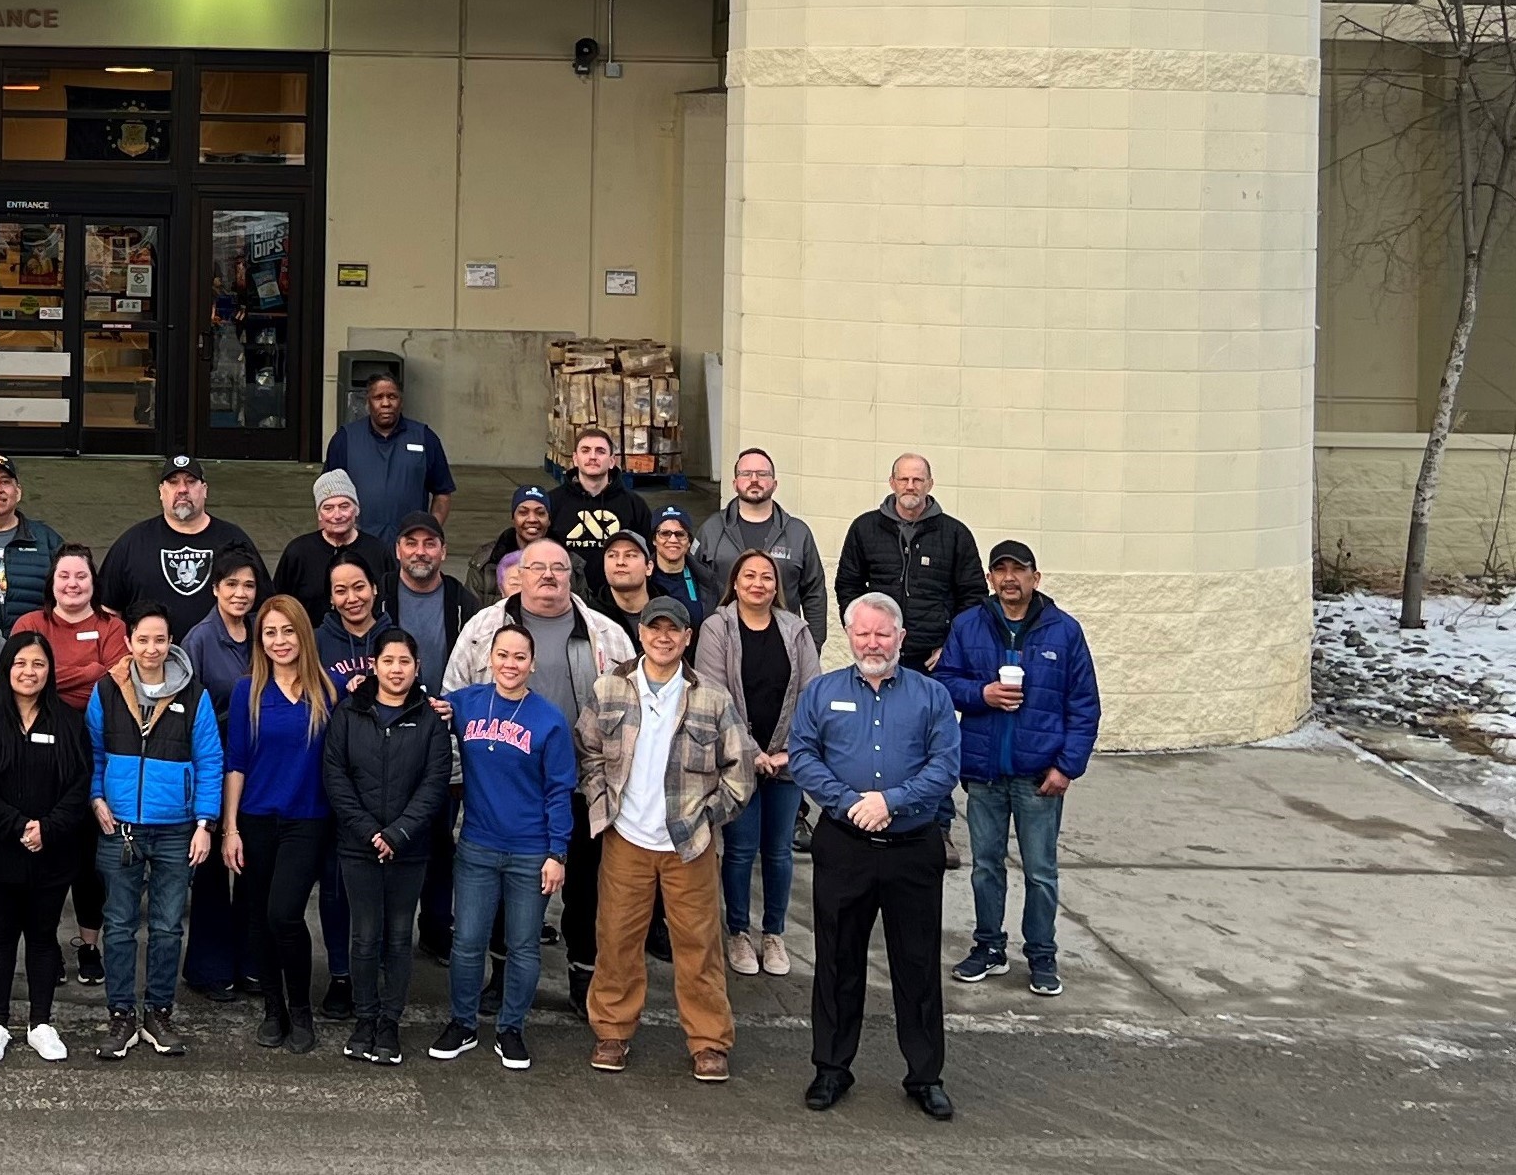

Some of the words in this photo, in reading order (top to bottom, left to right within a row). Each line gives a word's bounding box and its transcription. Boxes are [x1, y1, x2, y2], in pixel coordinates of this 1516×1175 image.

[6, 201, 50, 210] ENTRANCE
[254, 238, 284, 258] DIPS
[463, 718, 531, 755] ALASKA
